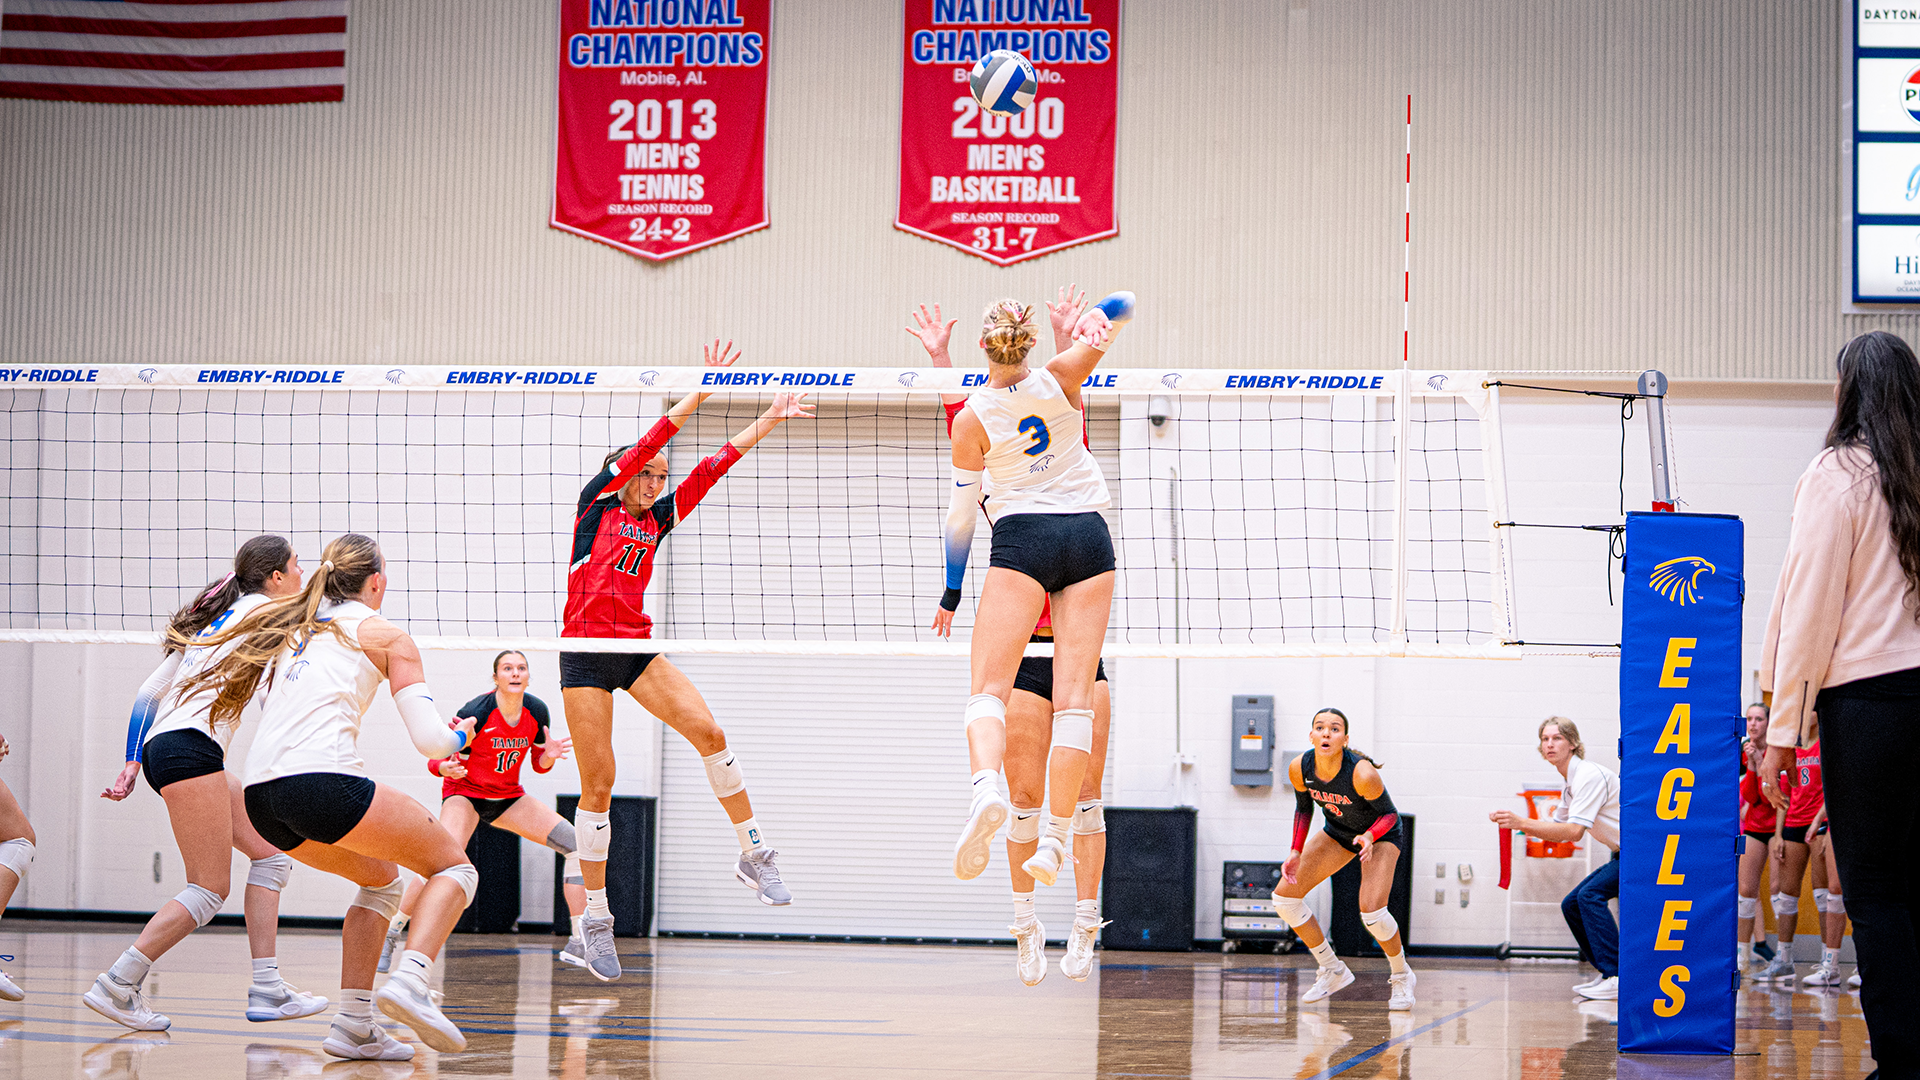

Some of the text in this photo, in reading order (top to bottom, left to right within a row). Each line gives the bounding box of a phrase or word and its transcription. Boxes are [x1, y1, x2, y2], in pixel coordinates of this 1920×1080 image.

[589, 0, 744, 28] NATIONAL
[932, 0, 1091, 25] NATIONAL
[1864, 9, 1920, 20] DAYTON
[568, 32, 763, 68] CHAMPIONS
[912, 29, 1111, 64] CHAMPIONS
[684, 71, 707, 86] Al.
[1036, 69, 1066, 84] Mo.
[608, 99, 717, 141] 2013
[625, 143, 700, 170] MEN'S
[967, 144, 1045, 171] MEN'S
[618, 174, 705, 201] TENNIS
[930, 176, 1081, 203] BASKETBALL
[607, 203, 713, 215] SEASON RECORD
[951, 212, 1060, 224] SEASON RECORD
[628, 217, 691, 242] 24-2
[972, 226, 1038, 251] 31-7
[197, 369, 345, 384] EMBRY-RIDDLE
[445, 371, 598, 386] EMBRY-RIDDLE
[701, 372, 856, 387] EMBRY-RIDDLE
[1225, 375, 1384, 390] EMBRY-RIDDLE
[1017, 414, 1051, 457] 3
[614, 542, 648, 577] 11
[490, 736, 529, 749] TAMPA
[494, 750, 520, 773] 16
[1801, 766, 1810, 786] 8
[1308, 787, 1353, 805] TAMPA
[1652, 636, 1697, 1018] EAGLES
